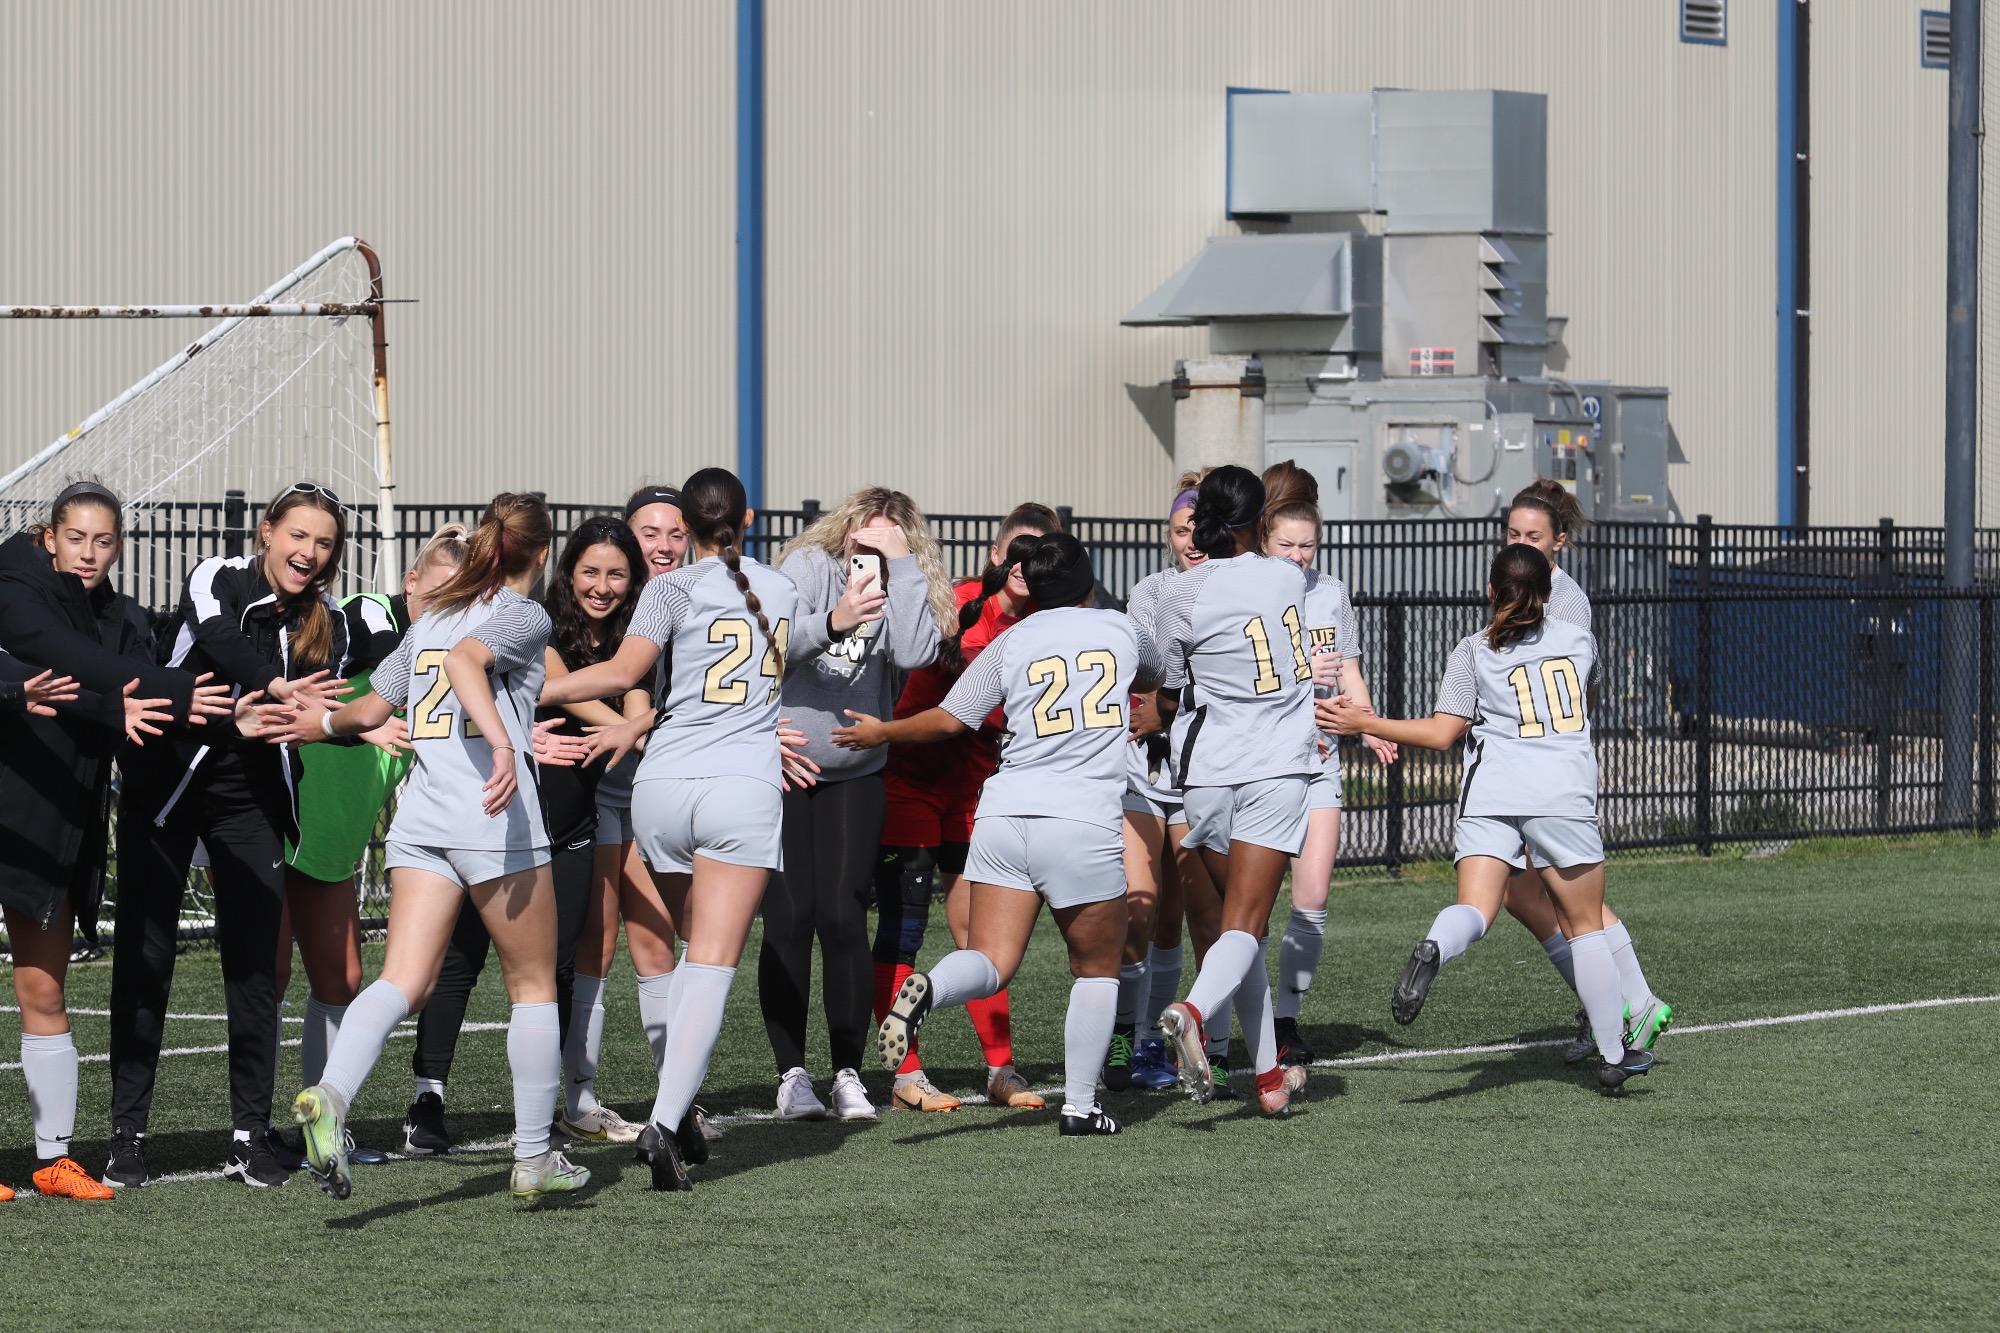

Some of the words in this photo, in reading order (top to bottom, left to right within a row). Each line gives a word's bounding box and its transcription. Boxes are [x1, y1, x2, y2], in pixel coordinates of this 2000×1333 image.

[411, 648, 484, 741] 2
[701, 617, 789, 706] 24
[1026, 648, 1123, 739] 22
[1243, 604, 1313, 696] 11
[1507, 656, 1585, 738] 10
